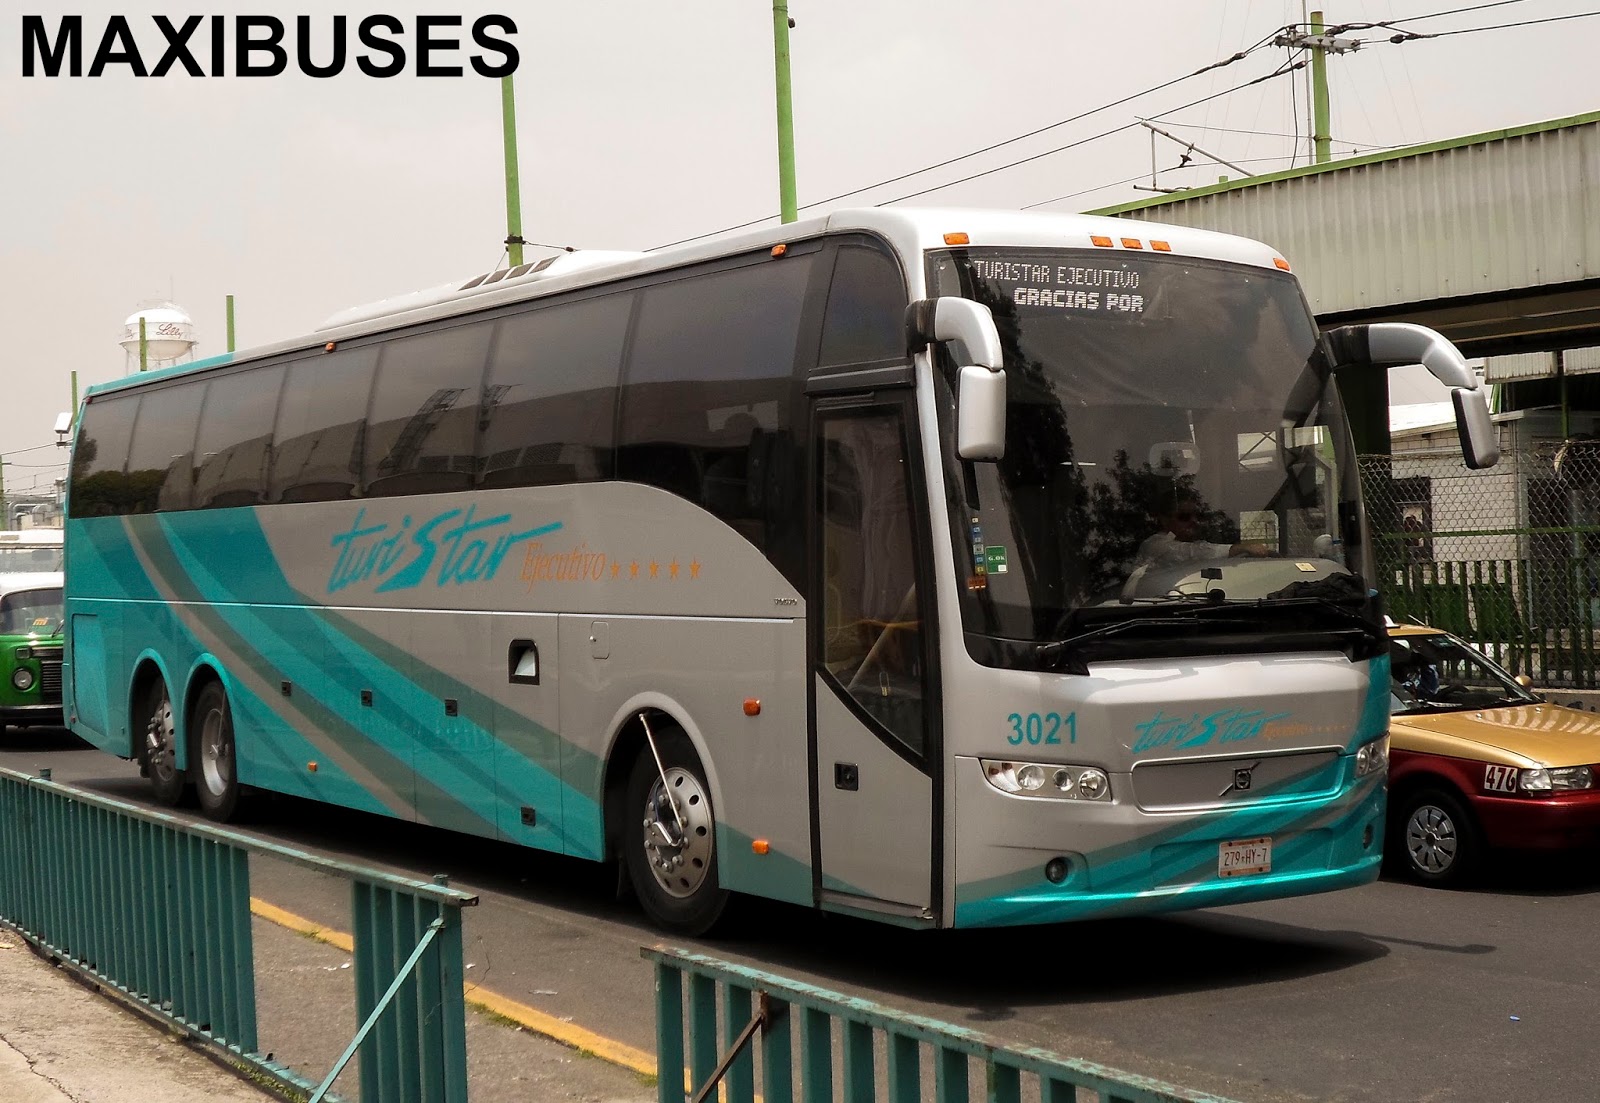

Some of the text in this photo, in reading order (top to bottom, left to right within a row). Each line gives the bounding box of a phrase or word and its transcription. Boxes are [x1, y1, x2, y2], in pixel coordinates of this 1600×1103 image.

[974, 260, 1140, 289] TURISTAR EJECUTIVO
[1014, 287, 1144, 312] GRACIAS POR
[520, 541, 607, 594] Ejecutivo
[1007, 711, 1078, 746] 3021
[1486, 766, 1516, 791] 476
